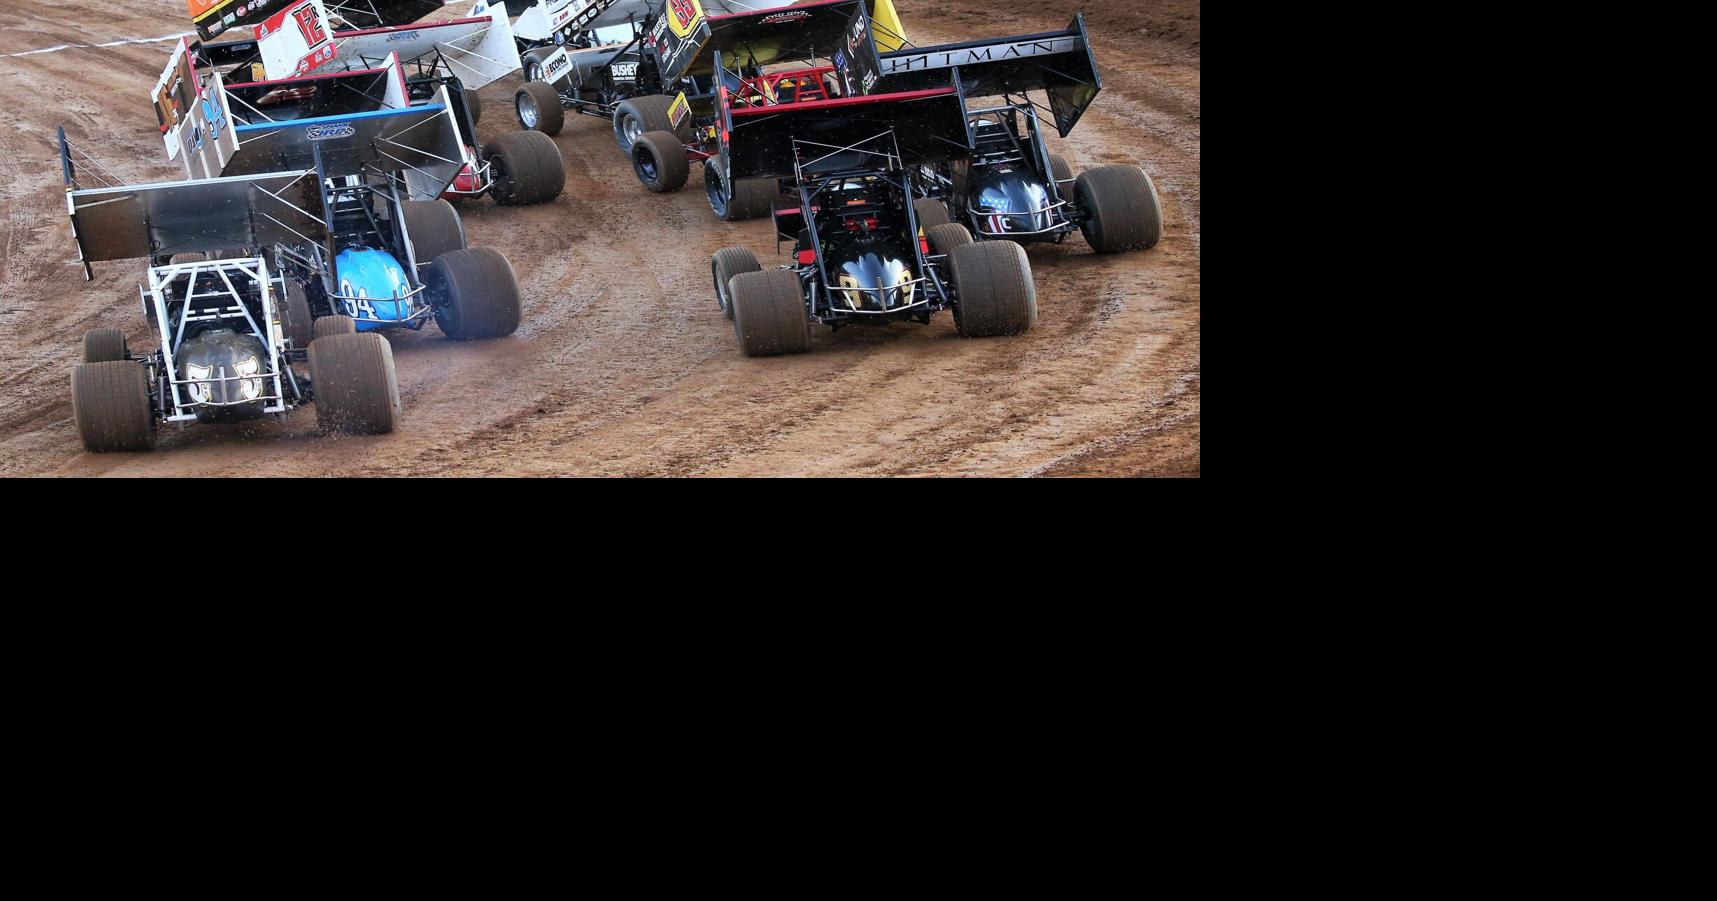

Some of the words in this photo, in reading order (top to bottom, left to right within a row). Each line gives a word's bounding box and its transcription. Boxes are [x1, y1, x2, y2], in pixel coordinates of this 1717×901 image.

[548, 53, 567, 74] ECONO
[611, 63, 639, 77] BUSHEY
[340, 277, 379, 320] 94
